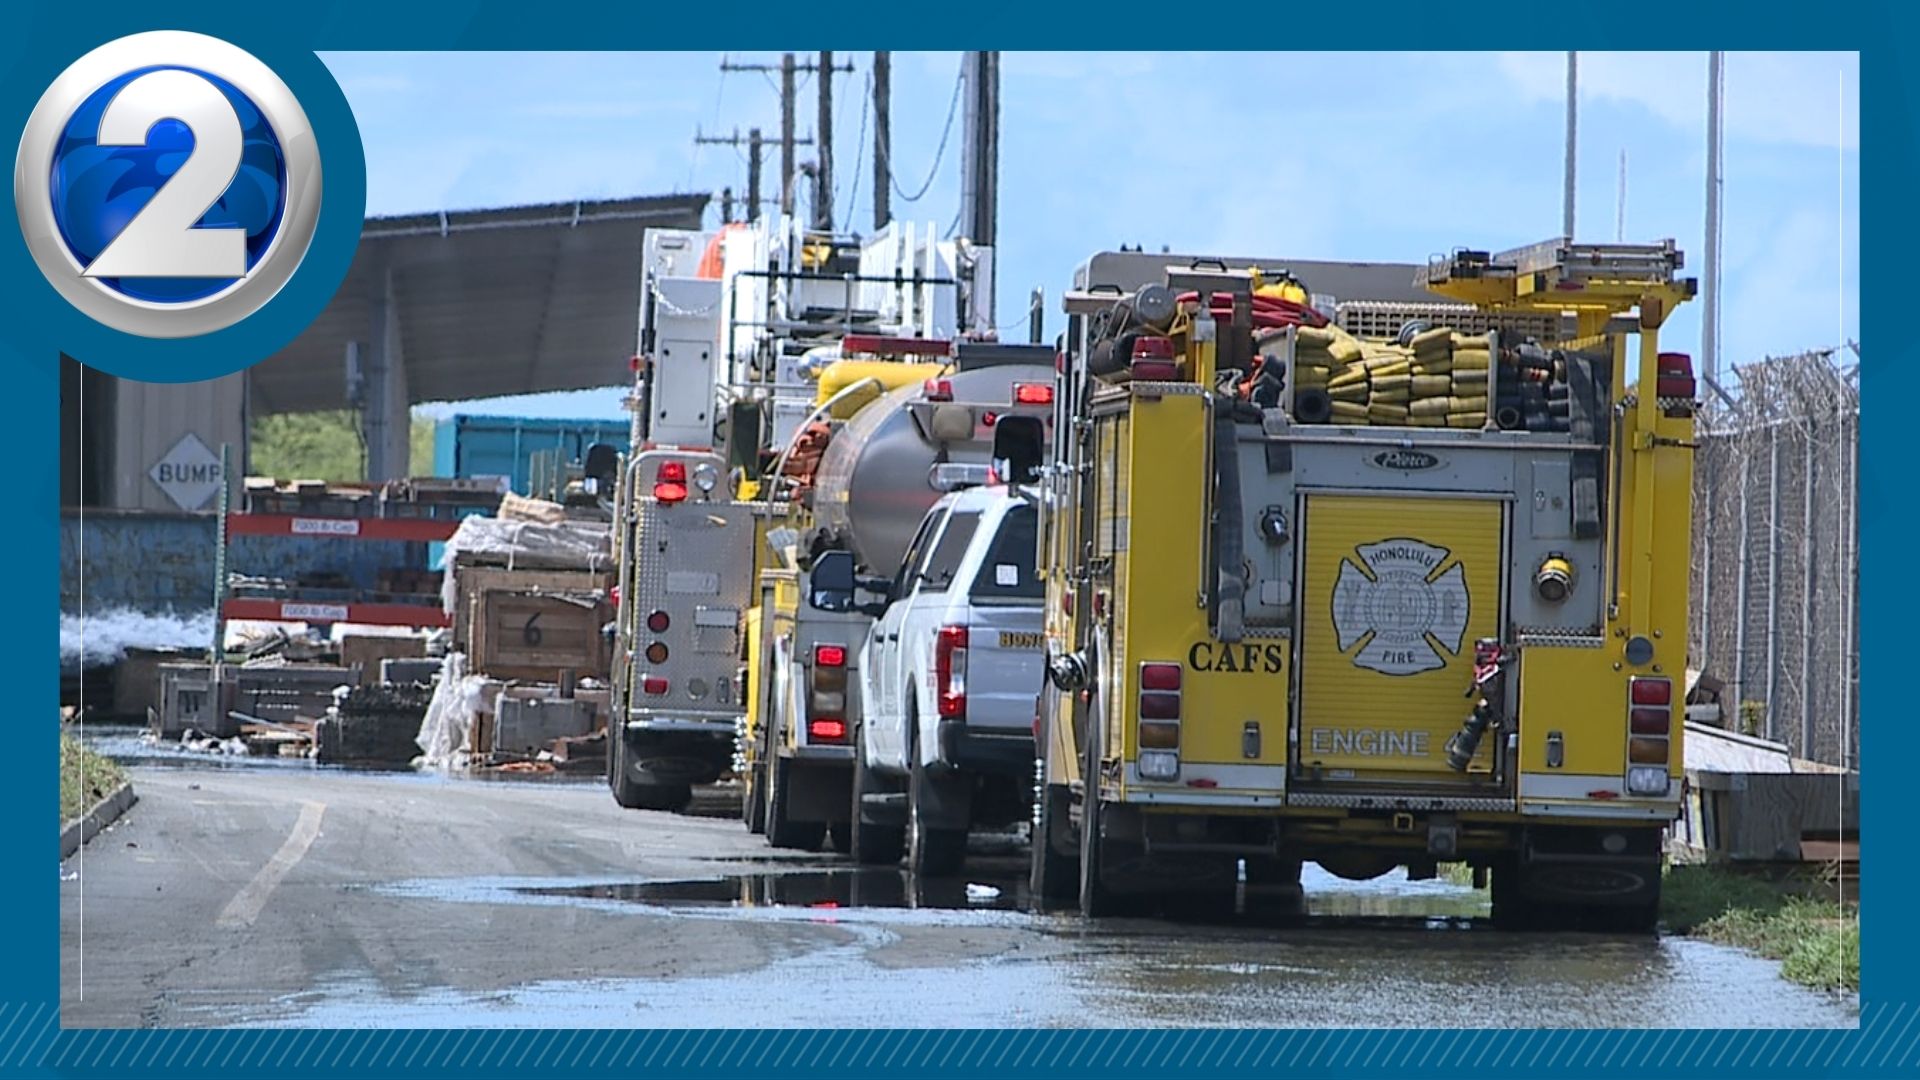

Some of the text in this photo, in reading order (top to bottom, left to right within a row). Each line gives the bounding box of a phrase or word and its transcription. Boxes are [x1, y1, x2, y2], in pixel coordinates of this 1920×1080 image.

[159, 463, 220, 483] BUMP
[1369, 547, 1435, 567] HONOLULU
[524, 609, 542, 648] 6
[1189, 641, 1283, 674] CAFS
[1382, 650, 1416, 664] FIRE
[1311, 728, 1430, 757] ENGINE
